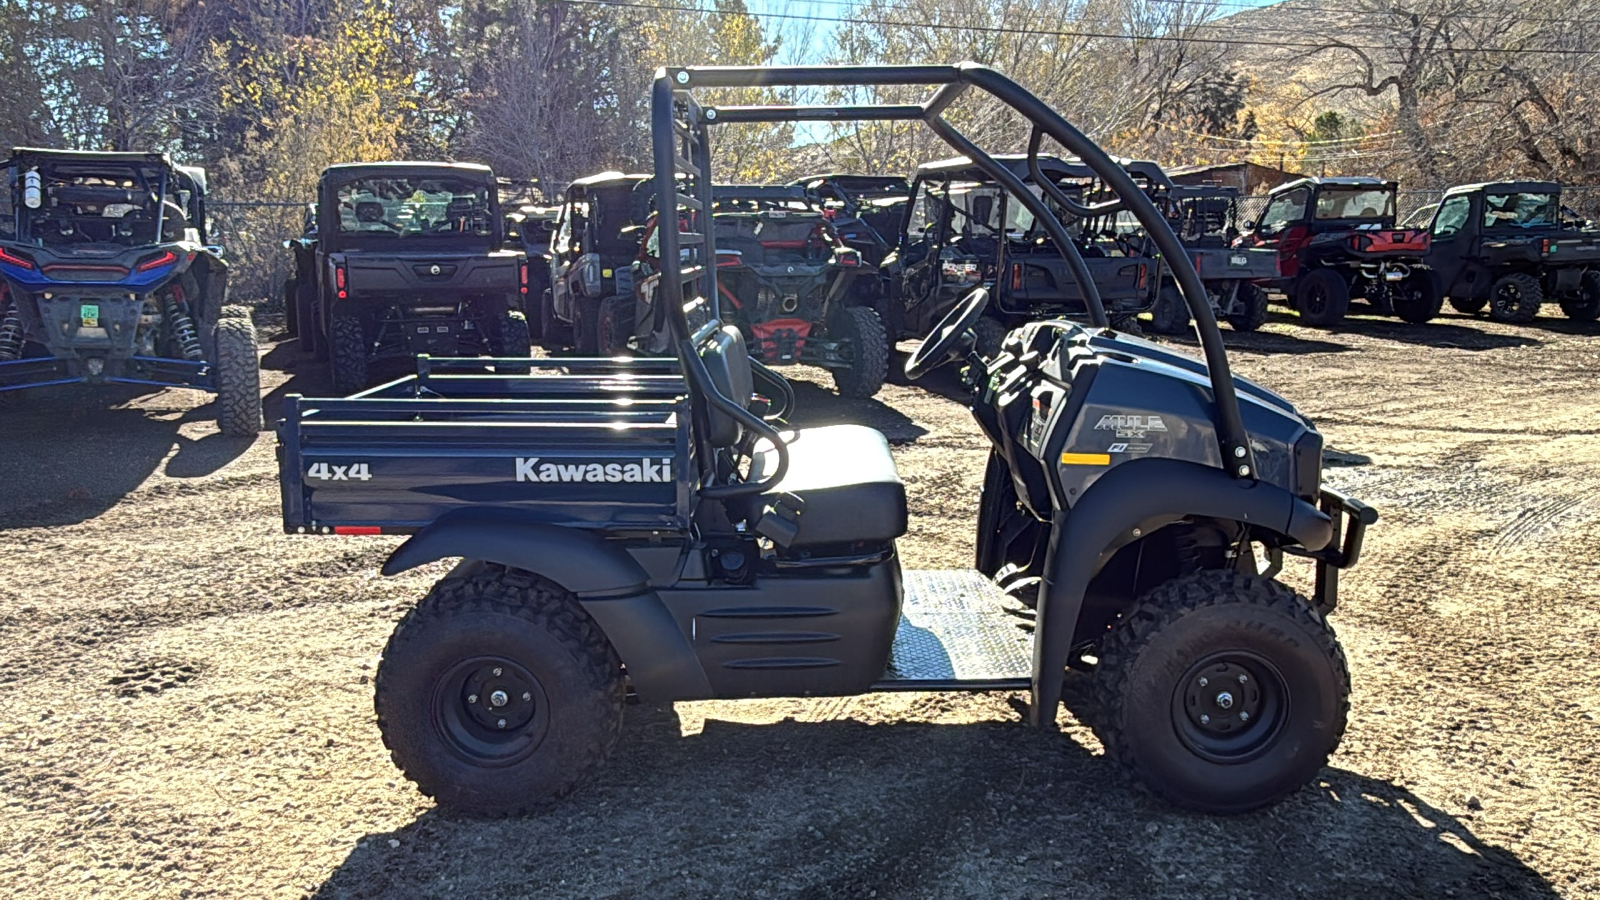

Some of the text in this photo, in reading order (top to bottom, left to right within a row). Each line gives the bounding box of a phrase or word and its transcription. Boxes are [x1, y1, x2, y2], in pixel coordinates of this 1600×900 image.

[1093, 414, 1168, 432] MULE
[1116, 430, 1146, 439] SX
[307, 462, 373, 481] 4x4
[515, 457, 672, 483] Kawasaki
